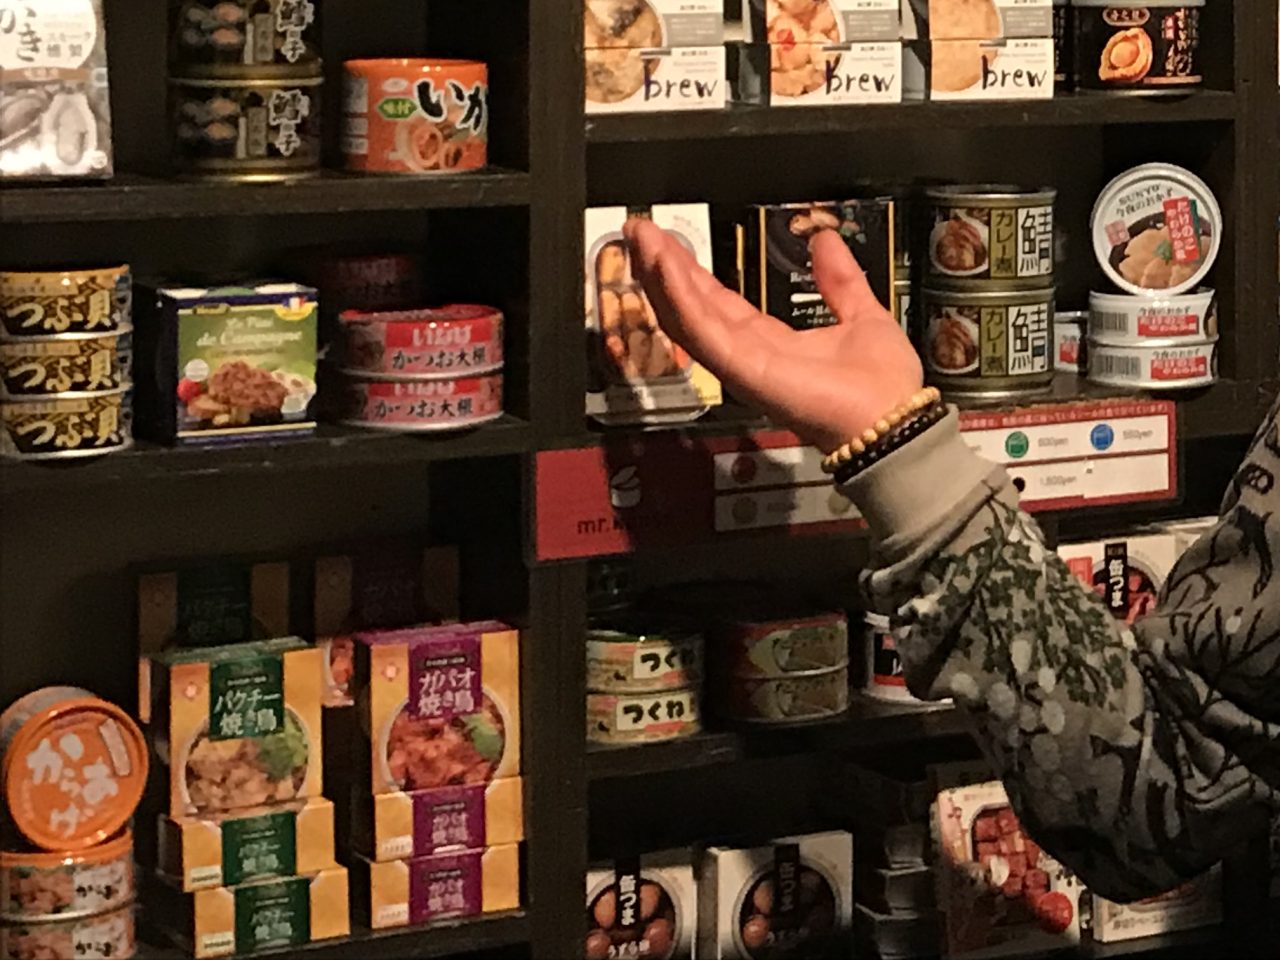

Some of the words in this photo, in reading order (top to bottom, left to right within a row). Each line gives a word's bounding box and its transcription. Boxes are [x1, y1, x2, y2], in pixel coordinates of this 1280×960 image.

[643, 59, 718, 101] brew
[825, 59, 895, 95] brew
[981, 54, 1047, 90] brew
[1019, 208, 1053, 276] 鯖
[1010, 305, 1049, 372] 鯖
[1108, 558, 1124, 608] 缶つま
[619, 874, 638, 927] 缶つま
